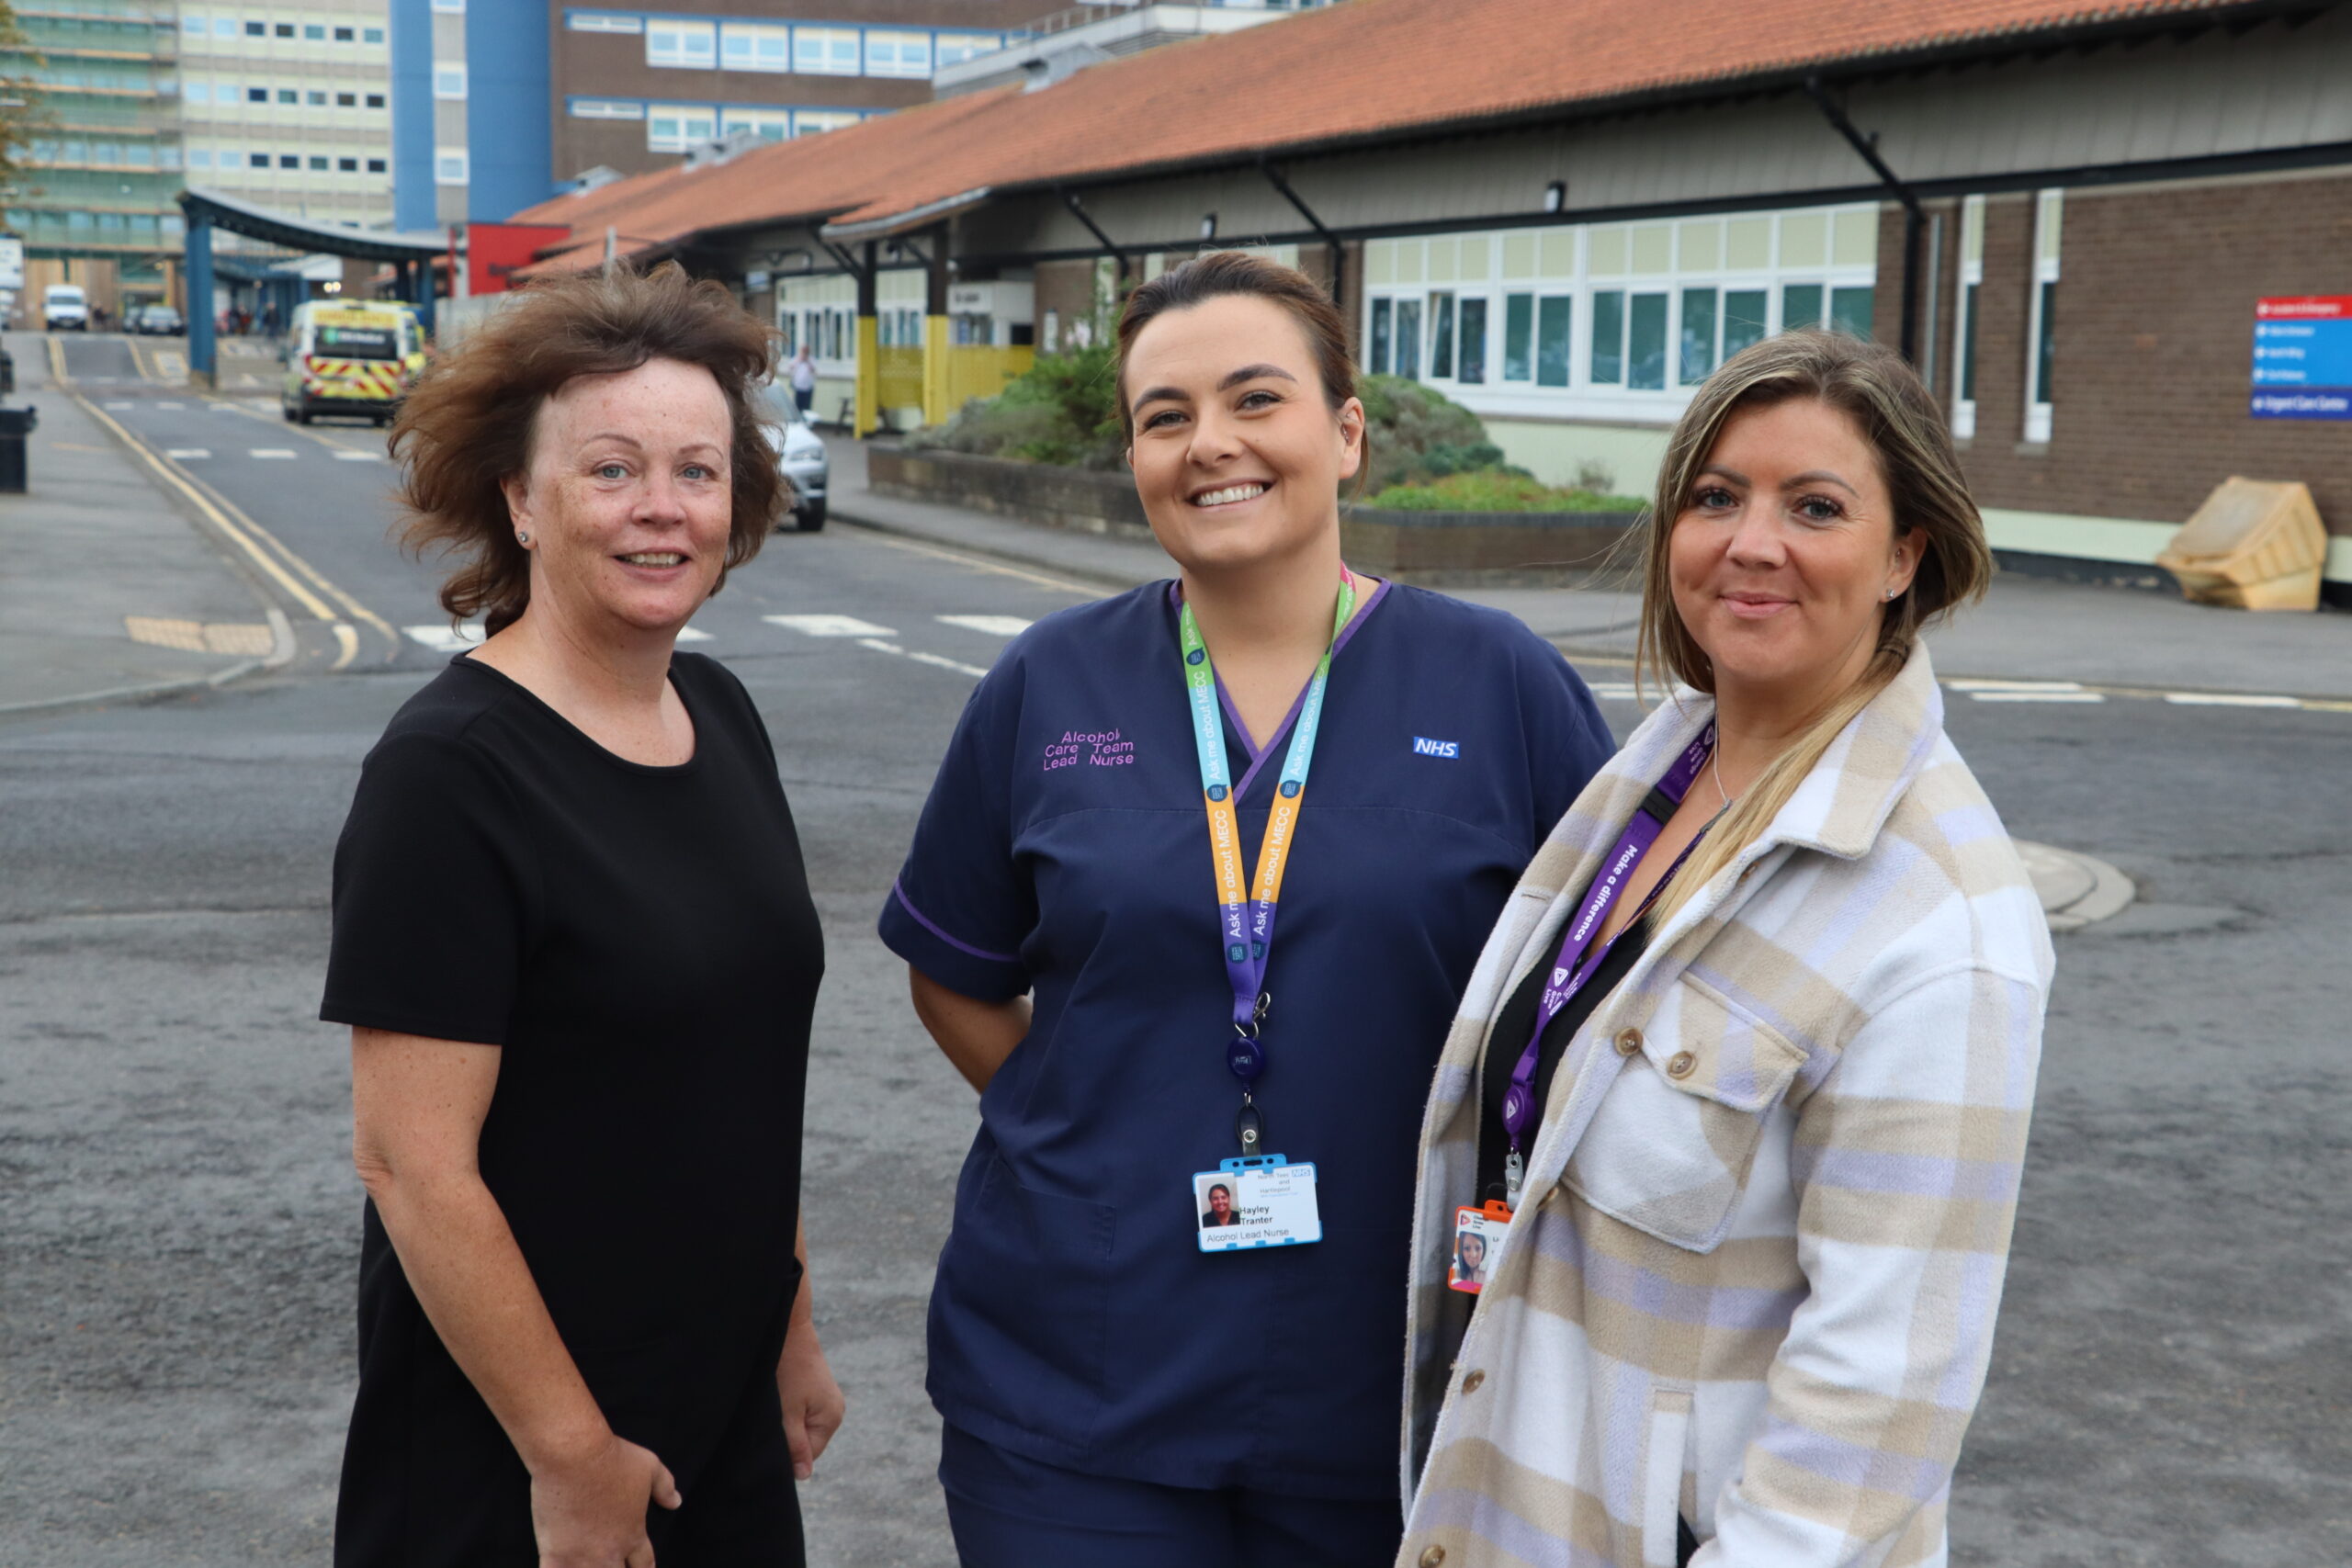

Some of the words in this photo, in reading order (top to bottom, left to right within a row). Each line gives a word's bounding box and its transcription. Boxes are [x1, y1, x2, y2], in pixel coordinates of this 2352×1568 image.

[1193, 671, 1210, 704] MECC
[1199, 705, 1215, 739] about
[1061, 728, 1121, 744] Alcohol
[1289, 754, 1304, 776] Ask
[1298, 735, 1308, 752] me
[1304, 696, 1317, 732] about
[1045, 744, 1080, 758] Care
[1092, 741, 1134, 754] Team
[1207, 740, 1217, 757] me
[1415, 738, 1457, 757] NHS
[1044, 753, 1078, 771] Lead
[1089, 754, 1135, 766] Nurse
[1208, 759, 1220, 780] Ask
[1215, 809, 1231, 848] MECC
[1274, 807, 1291, 846] MECC
[1219, 849, 1236, 888] about
[1263, 847, 1282, 886] about
[1612, 844, 1638, 875] Make
[1606, 875, 1617, 886] a
[1227, 890, 1238, 911] me
[1261, 887, 1272, 909] me
[1227, 912, 1242, 938] Ask
[1253, 910, 1268, 937] Ask
[1574, 886, 1611, 942] difference
[1240, 1205, 1270, 1215] Hayley
[1240, 1216, 1273, 1226] Tranter
[1206, 1230, 1238, 1243] Alcohol
[1240, 1229, 1261, 1240] Lead
[1263, 1228, 1290, 1238] Nurse
